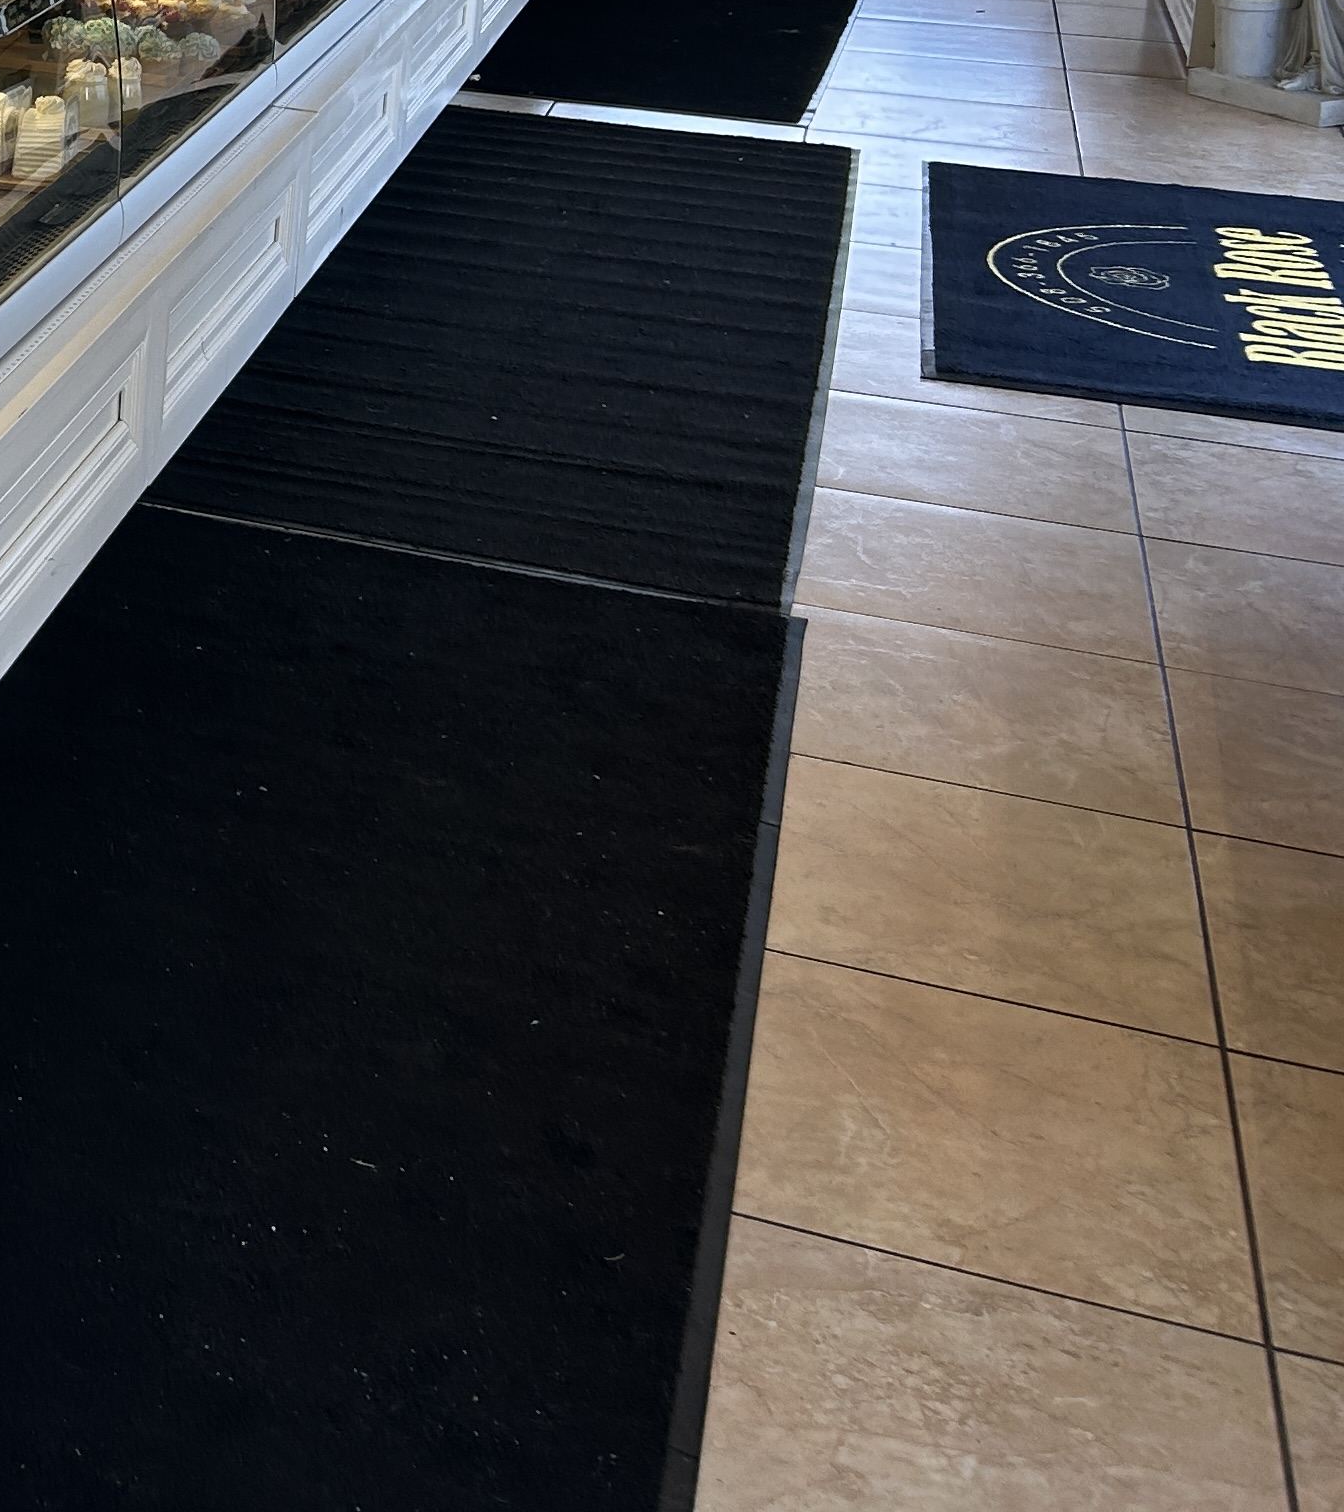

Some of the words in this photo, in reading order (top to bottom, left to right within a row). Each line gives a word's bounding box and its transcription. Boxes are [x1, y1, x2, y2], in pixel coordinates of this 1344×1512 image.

[1011, 231, 1111, 314] 508-366-1845
[1214, 227, 1335, 290] Rose
[1223, 288, 1344, 371] Black
